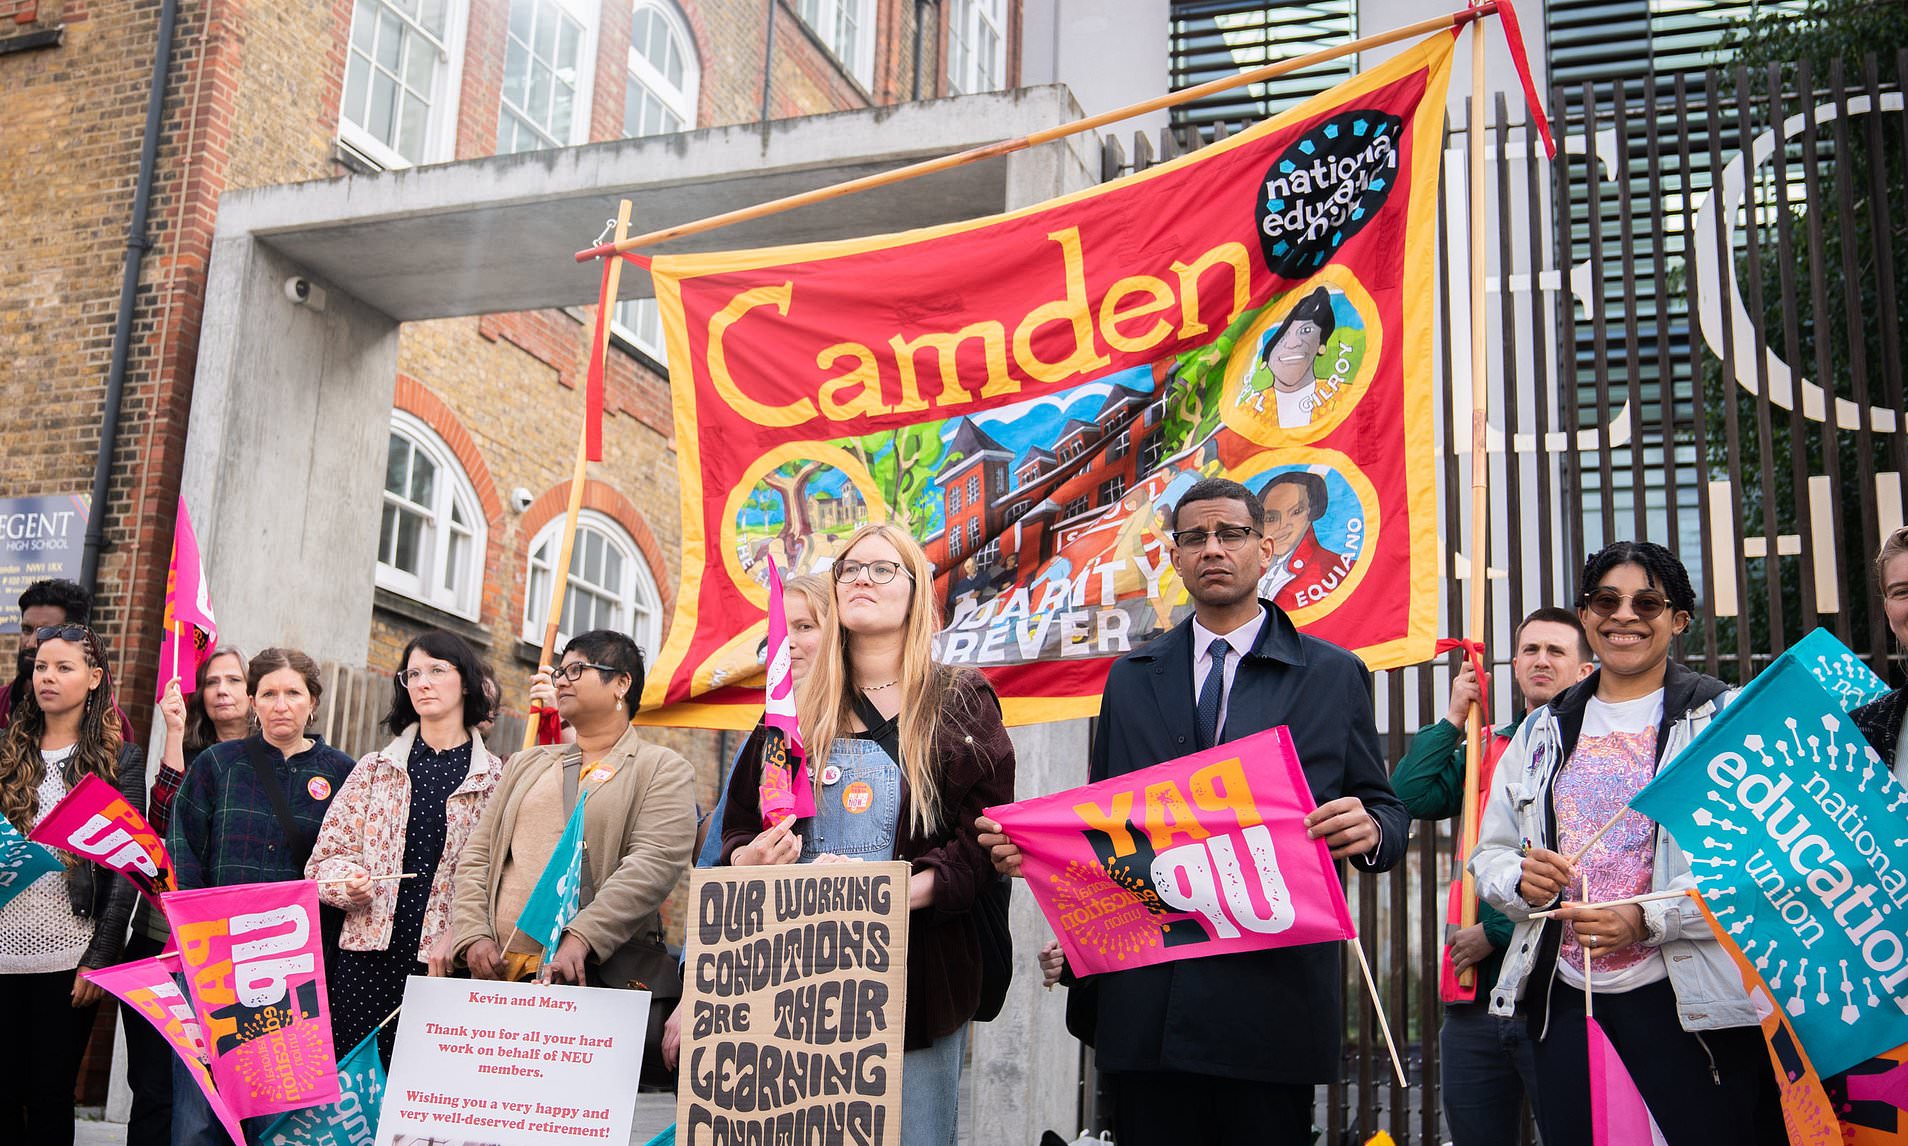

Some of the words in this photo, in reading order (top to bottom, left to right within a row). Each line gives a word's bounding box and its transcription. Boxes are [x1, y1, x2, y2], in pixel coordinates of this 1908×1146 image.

[707, 226, 1252, 428] Camden
[1298, 341, 1353, 413] GILROY
[31, 537, 69, 551] SCHOOL
[1295, 517, 1363, 608] EQUIANO
[67, 813, 159, 877] UP
[698, 879, 766, 945] OUR
[775, 875, 891, 922] WORKING
[1745, 848, 1825, 950] union
[696, 920, 890, 997] CONDITIONS
[469, 992, 507, 1006] Kevin
[510, 996, 535, 1007] and
[538, 997, 577, 1013] Mary,
[693, 1000, 751, 1040] ARE
[774, 979, 889, 1045] THEIR
[425, 1023, 468, 1037] Thank
[471, 1028, 495, 1040] you
[499, 1029, 520, 1041] for
[522, 1030, 540, 1042] all
[543, 1035, 576, 1046] your
[579, 1034, 613, 1048] hard
[438, 1041, 474, 1055] work
[477, 1046, 494, 1056] on
[497, 1046, 540, 1060] behalf
[543, 1049, 560, 1061] of
[561, 1051, 593, 1064] NEU
[478, 1063, 544, 1078] members.
[690, 1041, 887, 1112] LEARNING
[400, 1108, 428, 1122] very
[432, 1111, 525, 1131] well-deserved
[528, 1121, 610, 1139] retirement!
[406, 1090, 459, 1108] Wishing
[462, 1098, 487, 1111] you
[490, 1100, 498, 1110] a
[501, 1101, 532, 1115] very
[535, 1104, 579, 1119] happy
[582, 1107, 609, 1120] and
